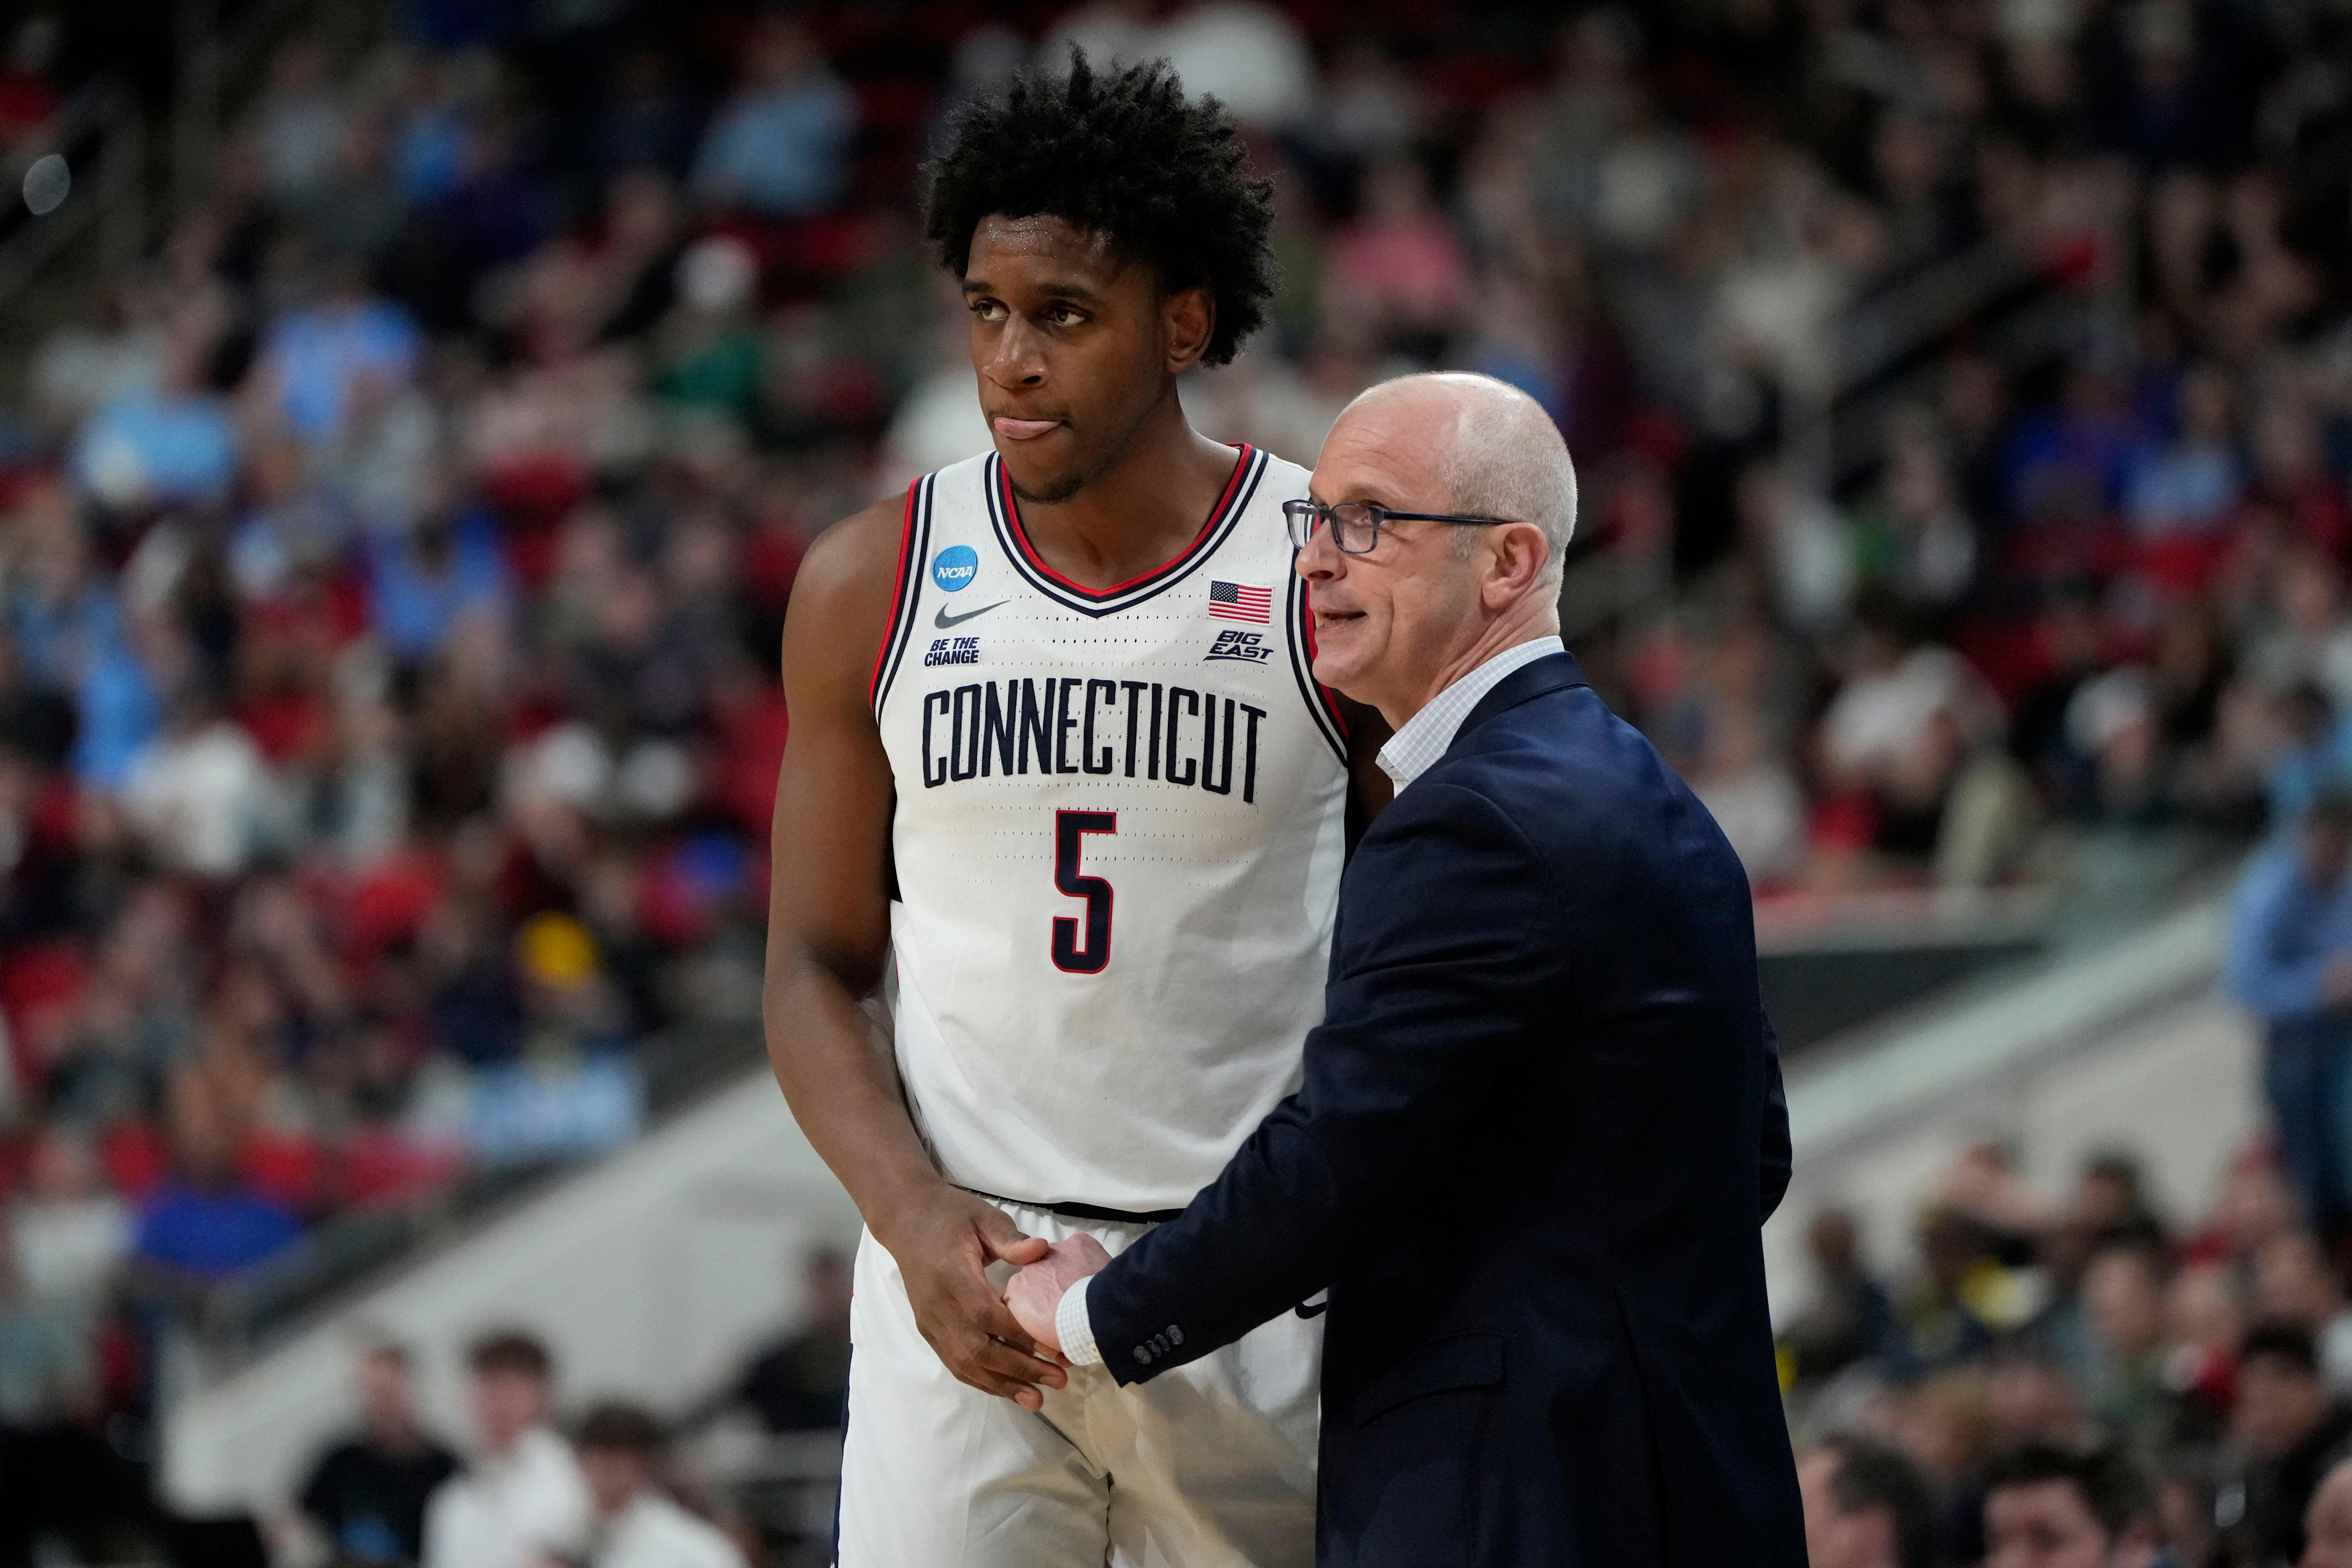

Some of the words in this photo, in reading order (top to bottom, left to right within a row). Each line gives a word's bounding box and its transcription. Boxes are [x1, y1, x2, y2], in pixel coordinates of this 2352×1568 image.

[937, 566, 973, 579] NCAA
[930, 638, 950, 651] BE
[953, 637, 980, 649] THE
[1217, 629, 1264, 645] BIG
[924, 650, 979, 667] CHANGE
[1209, 642, 1274, 659] EAST
[922, 678, 1267, 803] CONNECTICUT
[1051, 809, 1116, 974] 5
